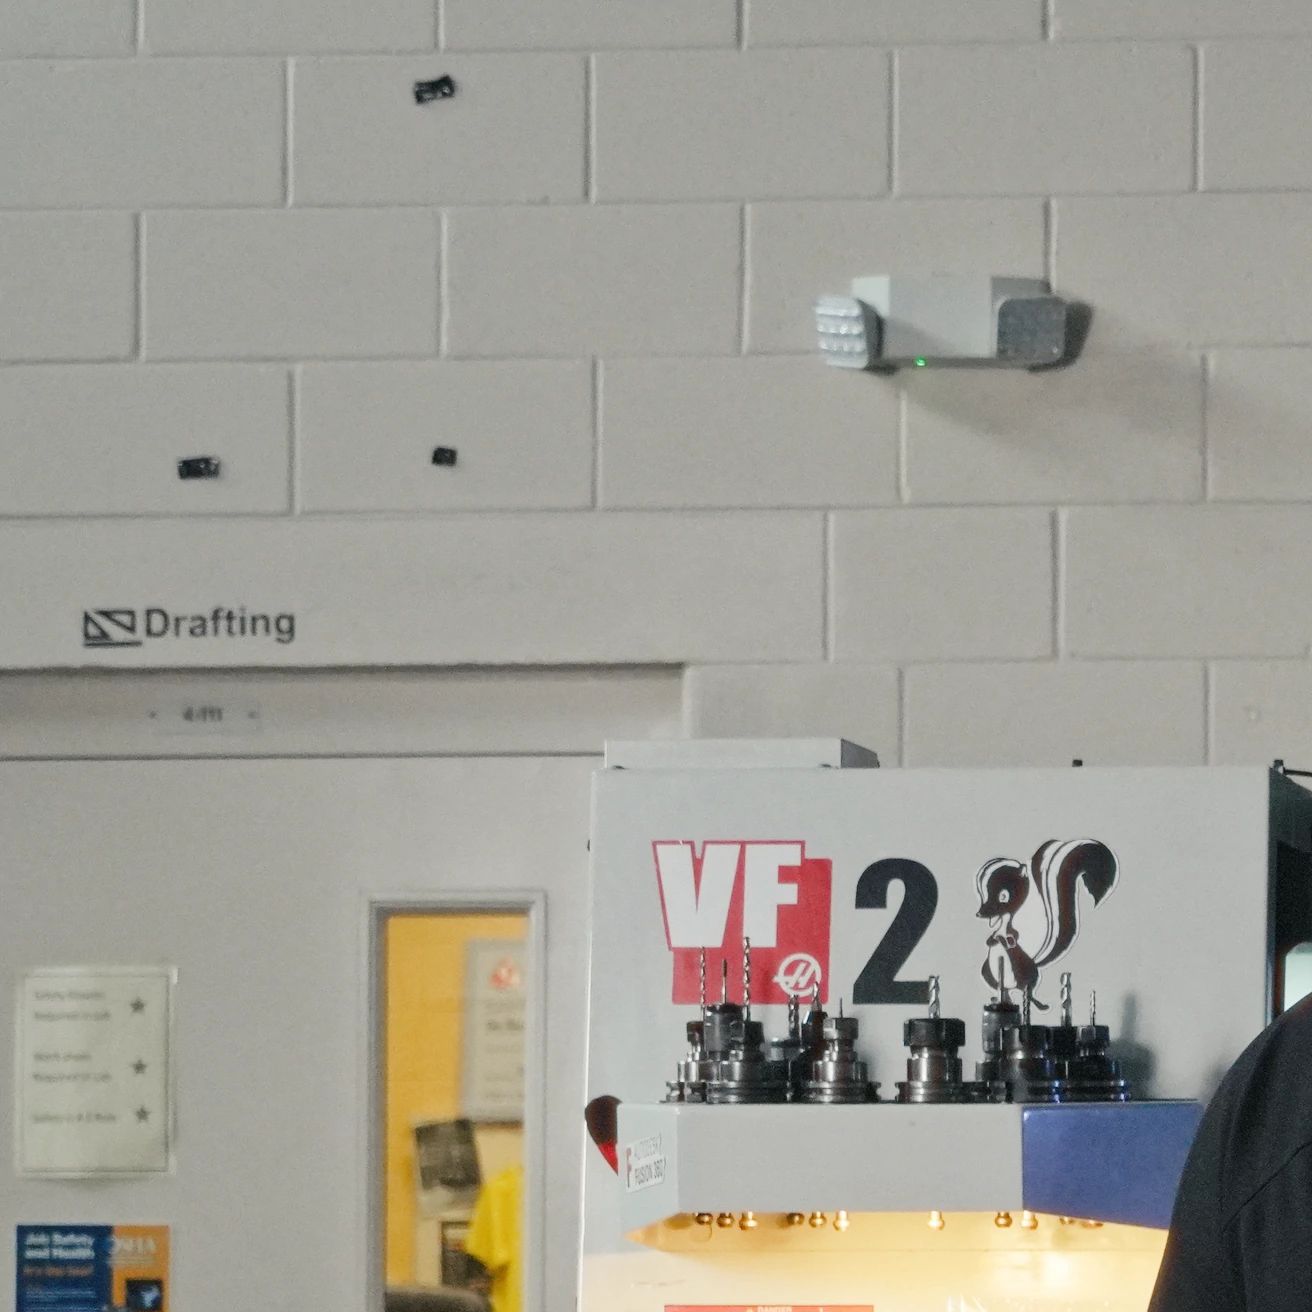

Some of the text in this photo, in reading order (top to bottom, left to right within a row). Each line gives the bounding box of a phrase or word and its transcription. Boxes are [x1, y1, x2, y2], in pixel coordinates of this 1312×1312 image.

[145, 605, 295, 644] Drafting
[652, 840, 938, 1005] VF 2
